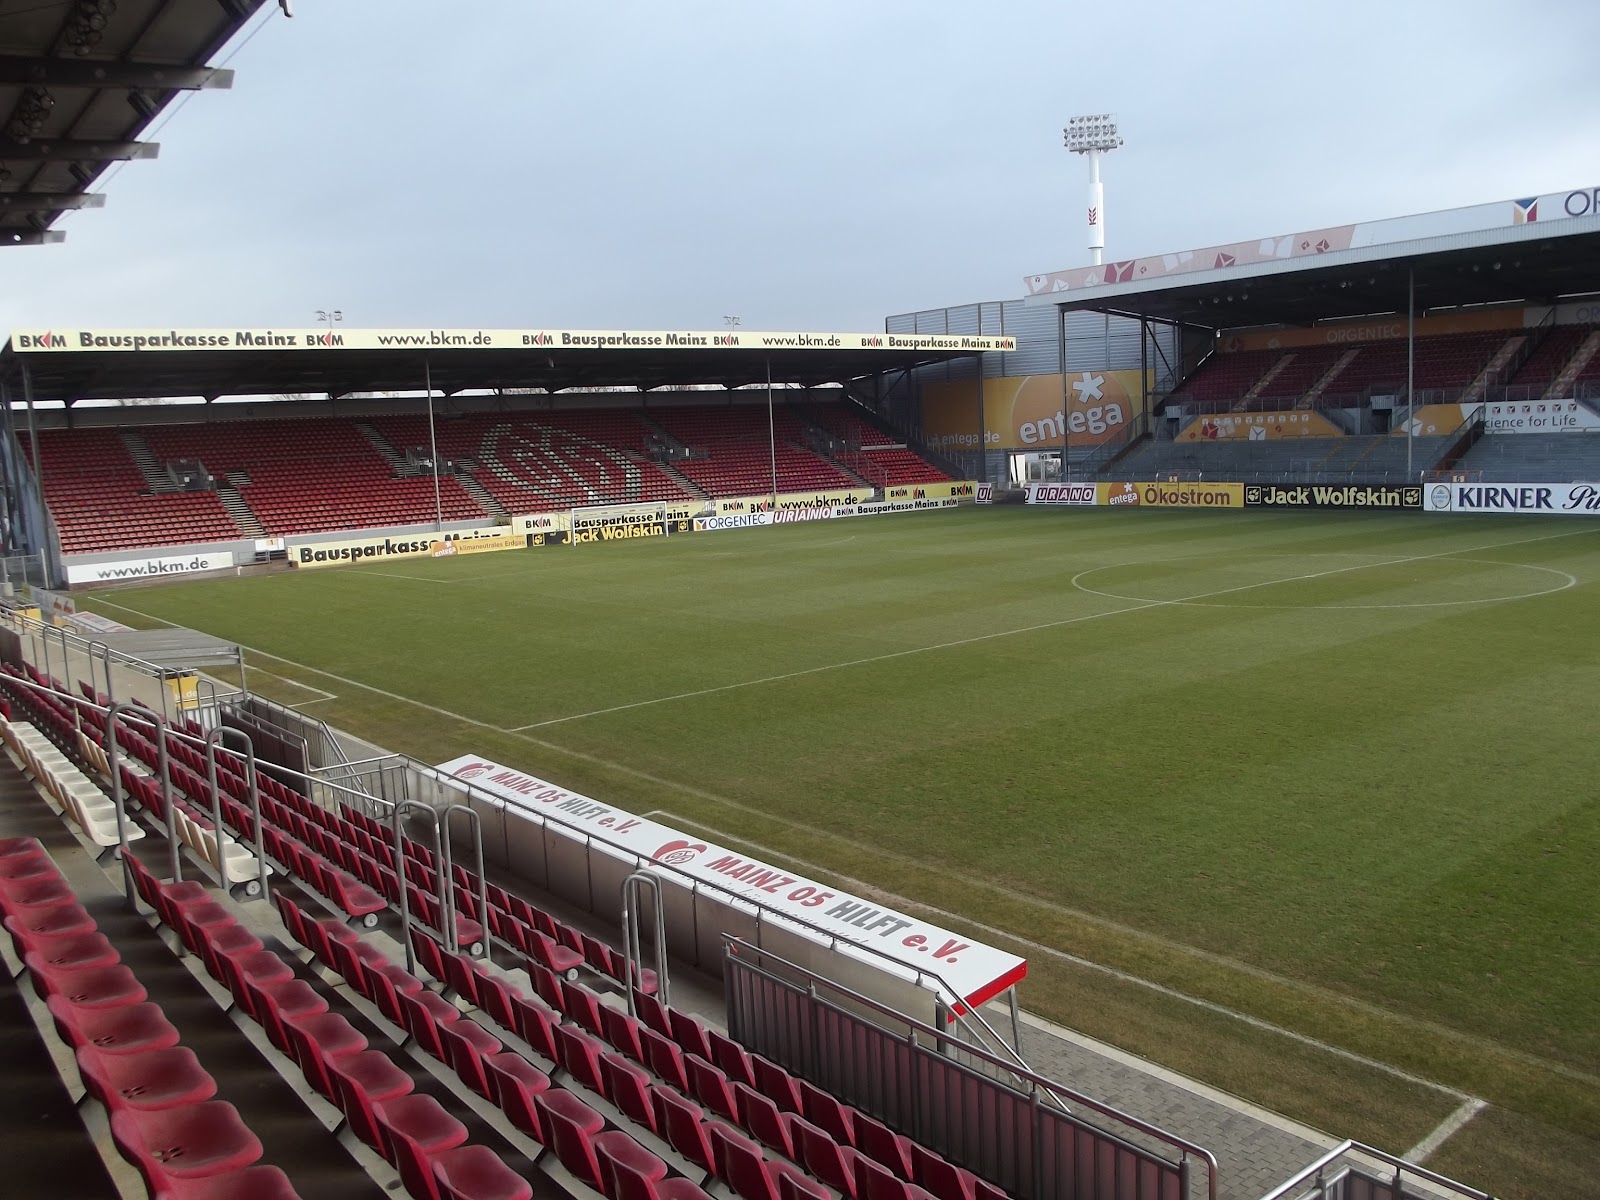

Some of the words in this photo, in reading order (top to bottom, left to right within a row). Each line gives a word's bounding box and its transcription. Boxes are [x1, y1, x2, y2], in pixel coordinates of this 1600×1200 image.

[20, 332, 67, 348] BKM
[80, 331, 229, 351] Bausparkasse
[236, 331, 297, 346] Mainz
[306, 331, 344, 347] BKM
[378, 331, 492, 345] www.bkm.de
[522, 332, 553, 345] BKM
[562, 332, 662, 349] Bausparkasse
[666, 332, 707, 346] Mainz
[714, 333, 739, 346] BKM
[762, 333, 841, 346] www.bkm.de
[861, 336, 883, 347] BKM
[1327, 324, 1400, 343] ORGENTEC
[889, 336, 959, 350] Bausparkasse
[961, 338, 991, 349] Mainz
[1019, 403, 1123, 444] entega
[1485, 417, 1523, 428] cience
[1529, 416, 1547, 426] for
[1552, 415, 1577, 426] Life
[781, 493, 858, 510] www.bkm.de
[1037, 488, 1094, 500] URANO
[1109, 492, 1138, 505] entega
[1144, 484, 1230, 505] Ökostrom
[1264, 487, 1310, 504] Jack
[1312, 487, 1400, 506] Wolfskin
[1458, 487, 1554, 509] KIRNER
[858, 501, 913, 514] Bausparkasse
[915, 500, 938, 509] Mainz
[526, 516, 551, 528] BKM
[573, 513, 653, 529] Bausparkasse
[709, 513, 766, 529] ORGENTEC
[600, 522, 664, 540] Wolfskin
[460, 541, 503, 551] klimaneutrales
[504, 539, 526, 548] Erdgas
[97, 557, 209, 579] www.bkm.de
[487, 771, 547, 795] MAINZ
[534, 789, 568, 803] 05
[555, 797, 613, 820] HILFT
[597, 817, 642, 834] e.V.
[704, 855, 797, 894] MAINZ
[787, 886, 835, 907] 05
[824, 900, 914, 938] HILFT
[901, 933, 971, 964] e.V.
